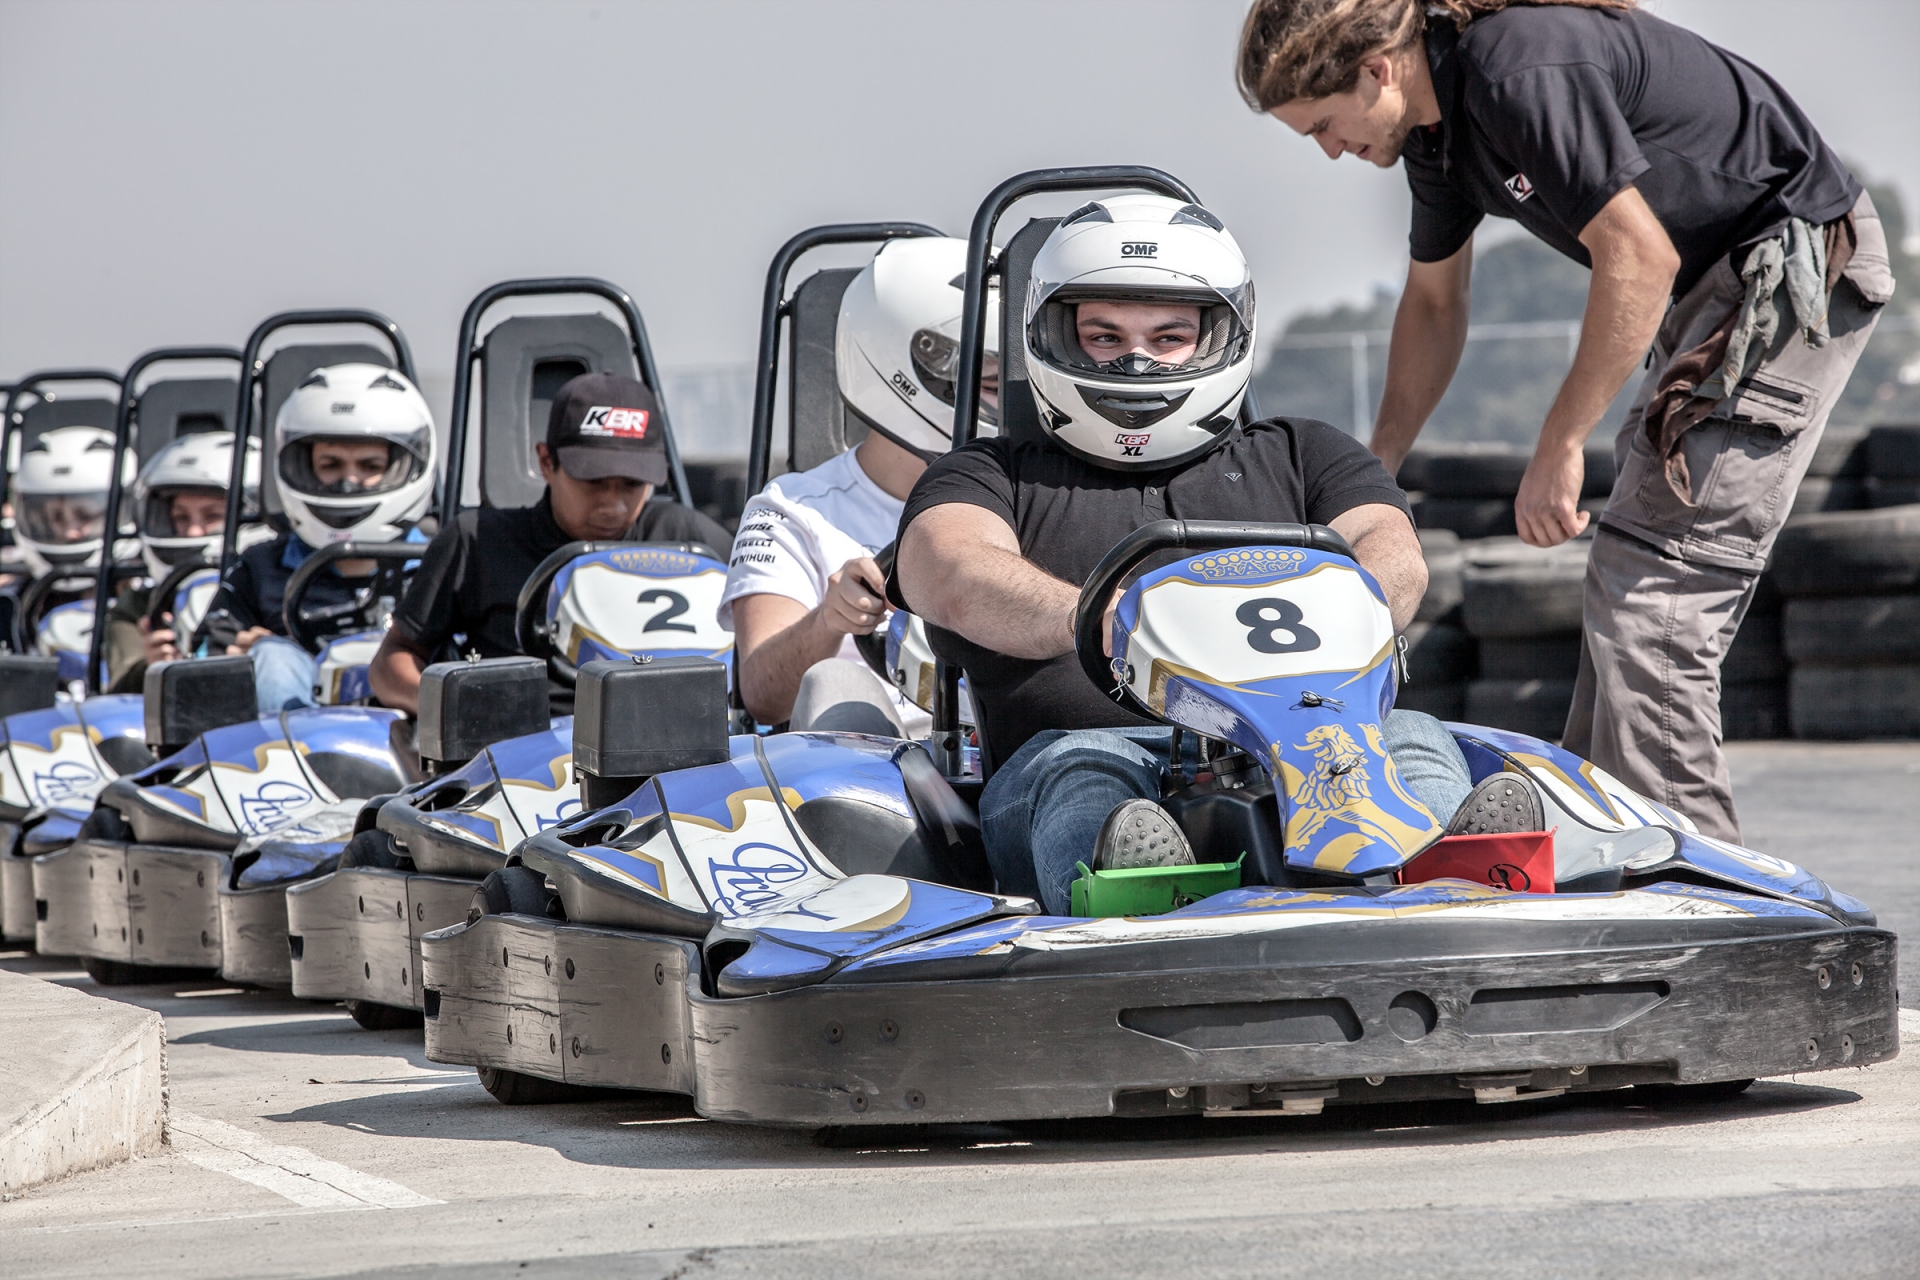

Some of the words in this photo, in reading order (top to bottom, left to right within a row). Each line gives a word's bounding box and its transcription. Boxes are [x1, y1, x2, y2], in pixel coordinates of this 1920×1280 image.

[1121, 244, 1158, 255] OMP
[893, 373, 917, 396] OMP
[585, 409, 645, 432] KBR
[1116, 434, 1150, 445] KBR
[1121, 446, 1144, 456] XL
[637, 588, 697, 634] 2
[1235, 597, 1321, 654] 8
